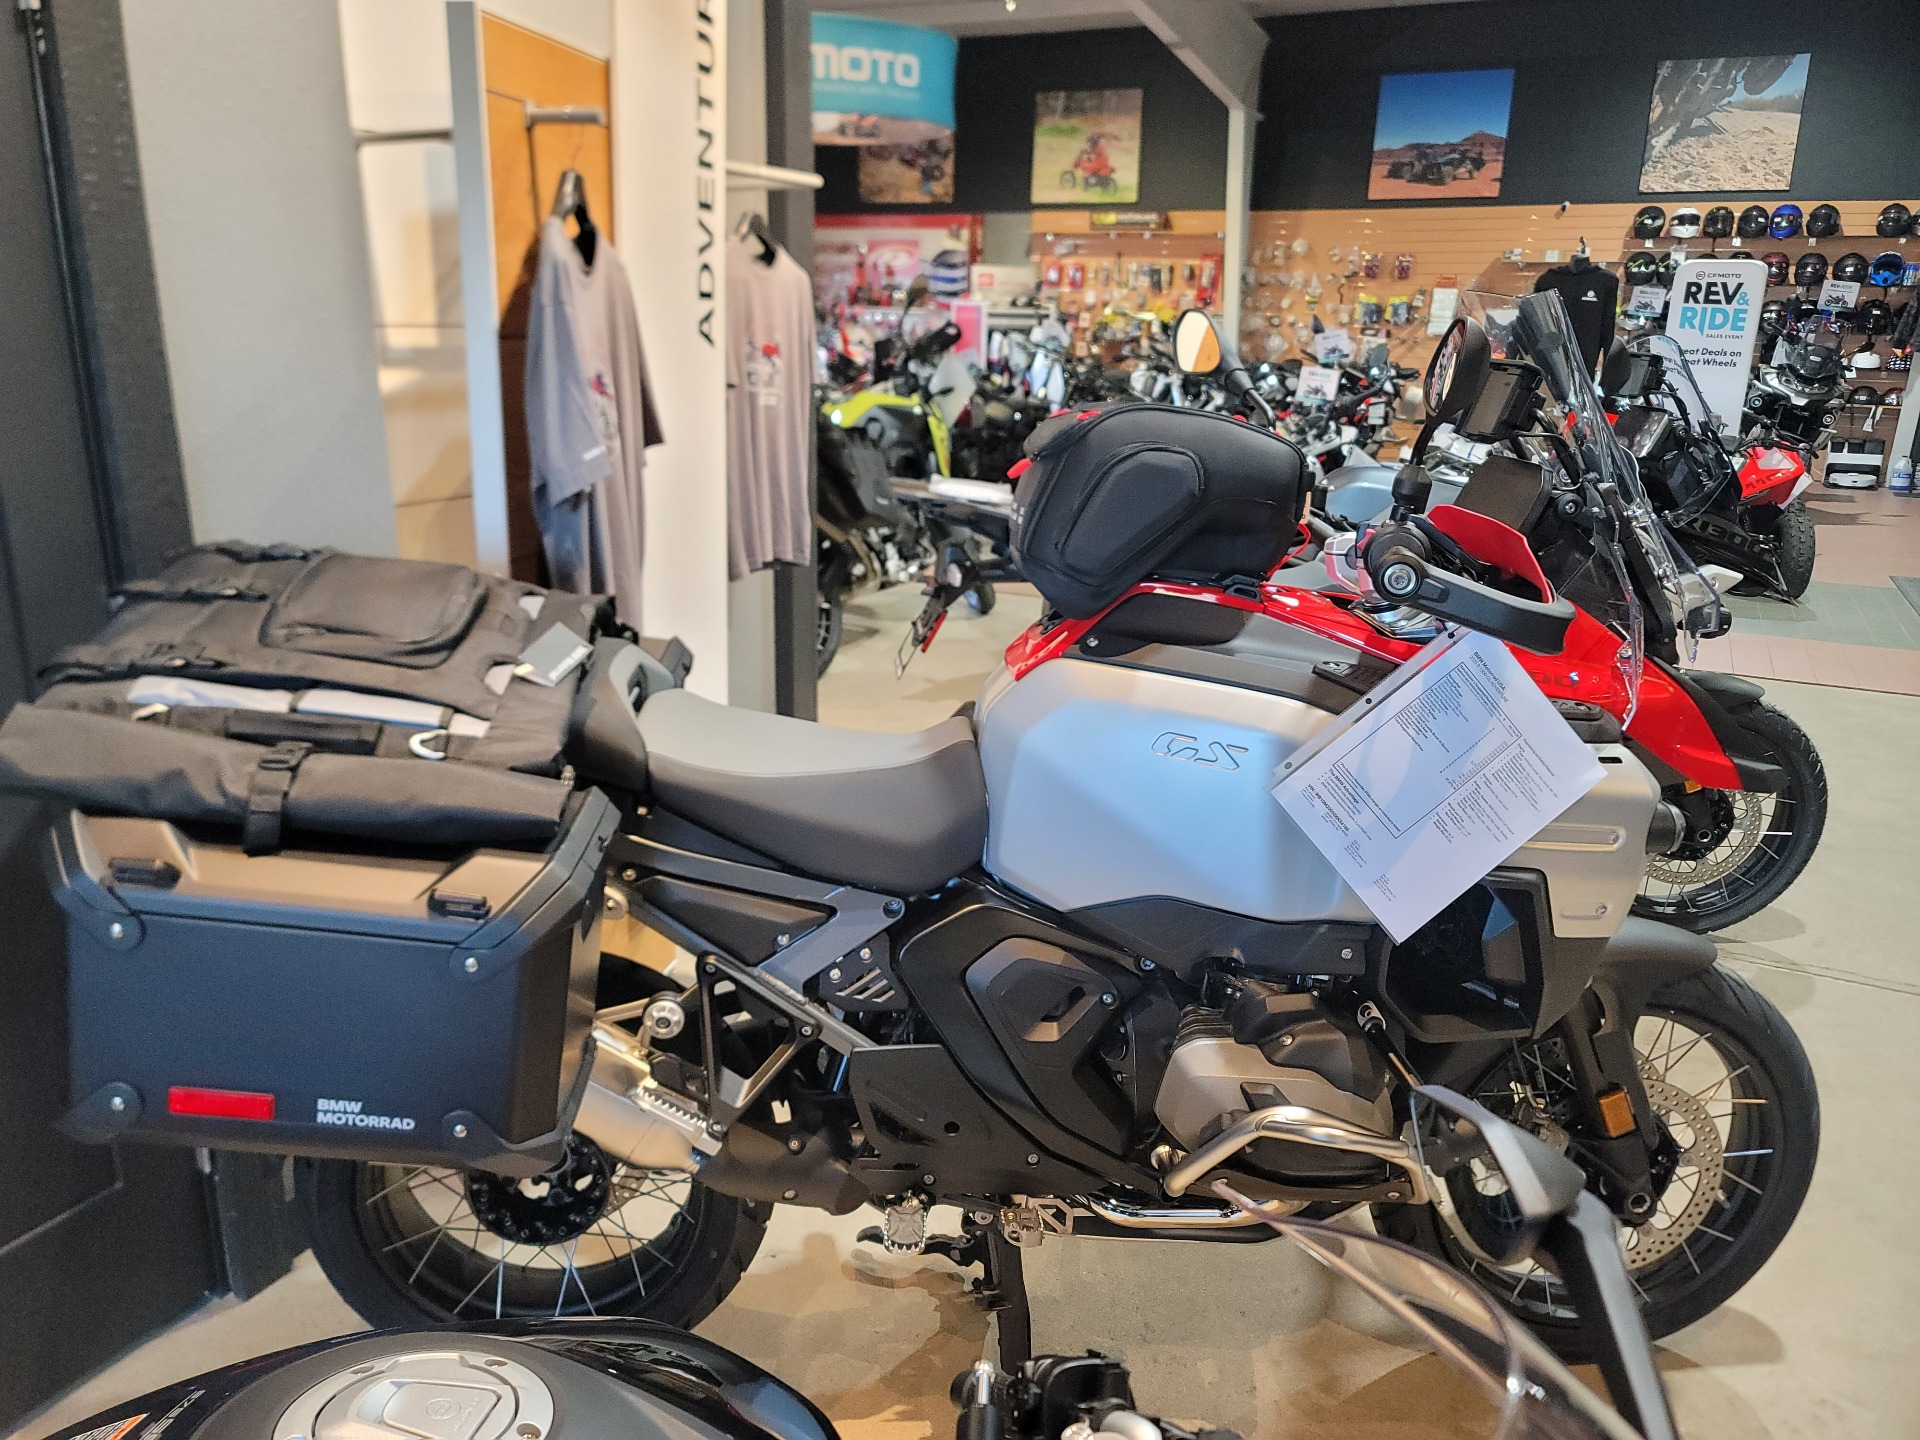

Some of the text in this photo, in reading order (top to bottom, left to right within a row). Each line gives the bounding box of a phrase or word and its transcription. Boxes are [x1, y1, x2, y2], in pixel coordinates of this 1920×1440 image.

[1679, 306, 1748, 336] RIDE
[1701, 347, 1728, 357] Deals
[1702, 358, 1738, 368] Wheels
[1151, 731, 1249, 771] GS
[316, 1098, 363, 1113] BMW
[316, 1111, 416, 1130] MOTORRAD
